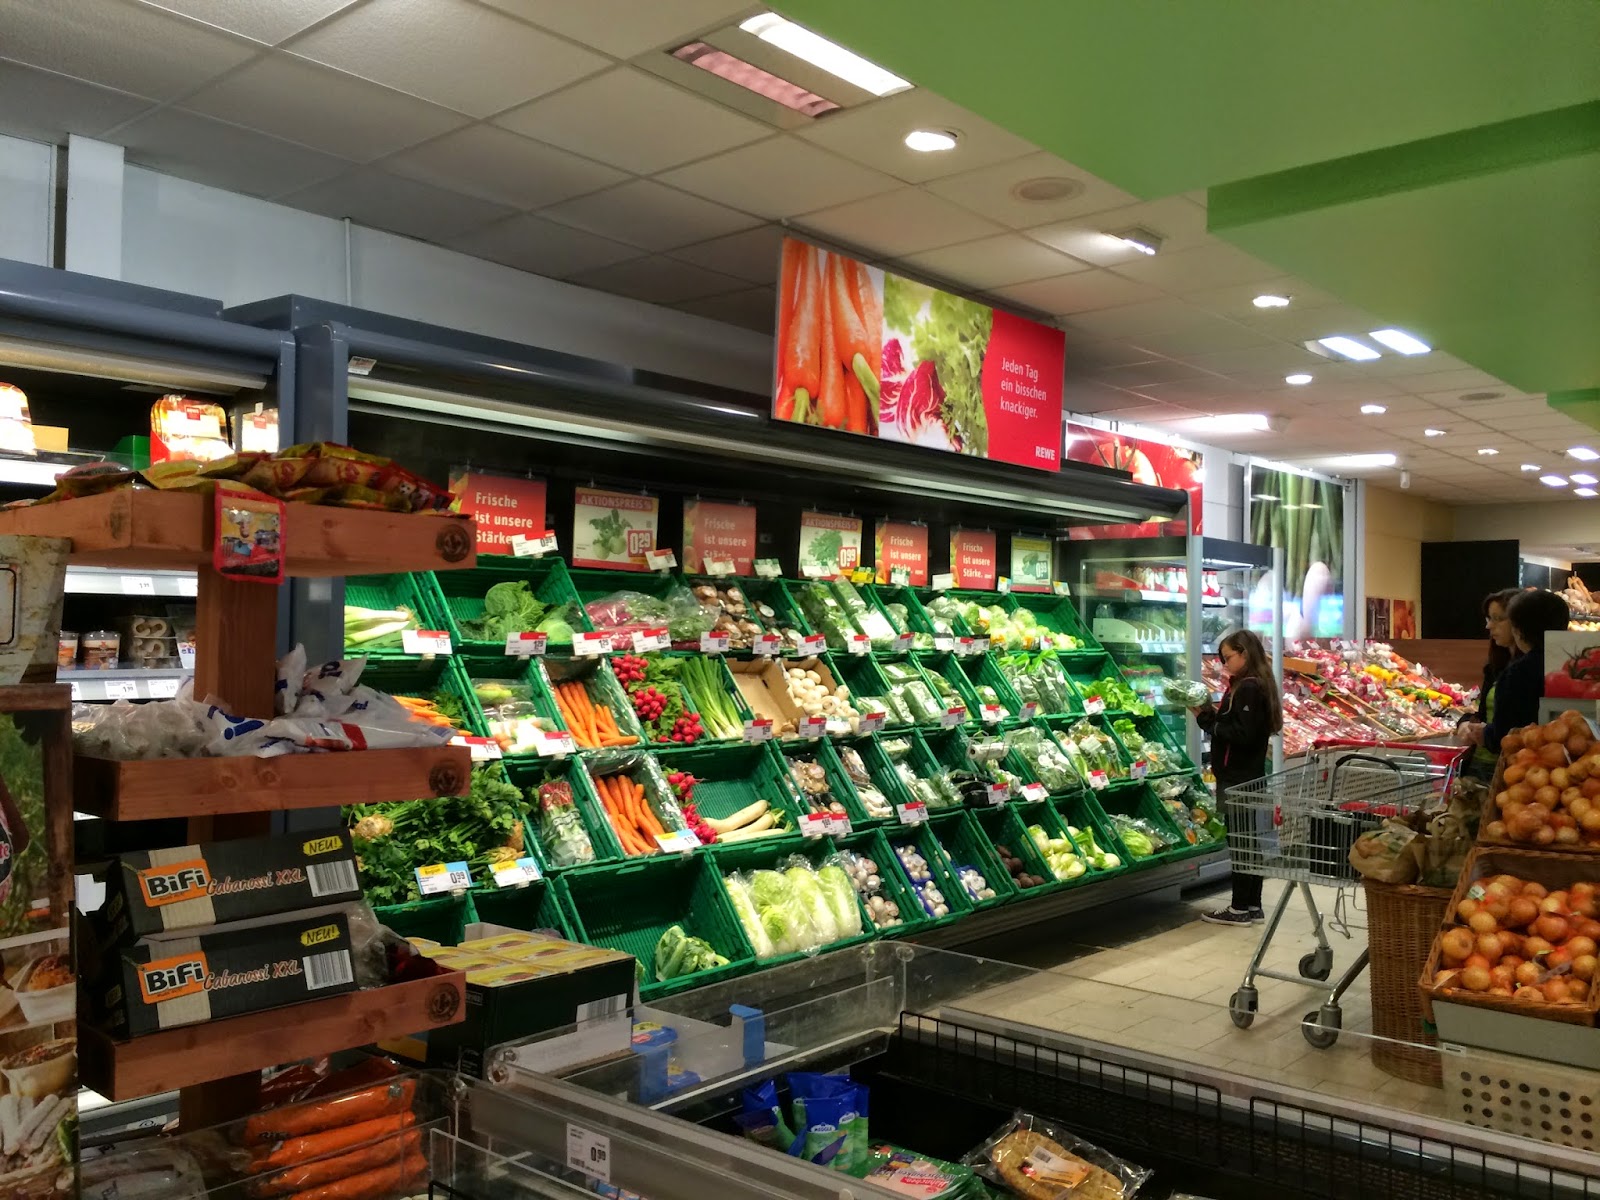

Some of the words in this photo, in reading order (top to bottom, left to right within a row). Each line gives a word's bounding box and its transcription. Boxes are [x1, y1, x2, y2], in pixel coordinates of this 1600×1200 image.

[1001, 357, 1023, 376] Jeden
[1025, 364, 1039, 383] Tag
[1001, 378, 1013, 392] ein
[1015, 380, 1047, 401] bisschen
[1000, 396, 1038, 420] knackiger.
[1035, 446, 1055, 460] REWE
[475, 491, 518, 508] Frische
[581, 495, 643, 509] AKTIONSPREIS
[475, 510, 490, 525] ist
[494, 515, 533, 528] unsere
[704, 518, 736, 530] Frische
[805, 518, 851, 529] AKTIONSPREIS
[704, 534, 716, 545] ist
[718, 537, 747, 547] unsere
[890, 536, 914, 547] Frische
[962, 542, 983, 553] Frische
[890, 549, 899, 558] ist
[900, 552, 922, 562] unsere
[962, 556, 971, 565] ist
[972, 558, 991, 567] unsere
[963, 568, 983, 579] Stärke.
[308, 837, 338, 855] NEU!
[146, 868, 207, 898] BiFi
[206, 871, 274, 896] Cabanossi
[275, 868, 307, 886] XXL
[306, 925, 335, 944] NEU!
[144, 961, 205, 995] BiFi
[204, 963, 270, 991] Cabanossi
[272, 959, 303, 979] XXL
